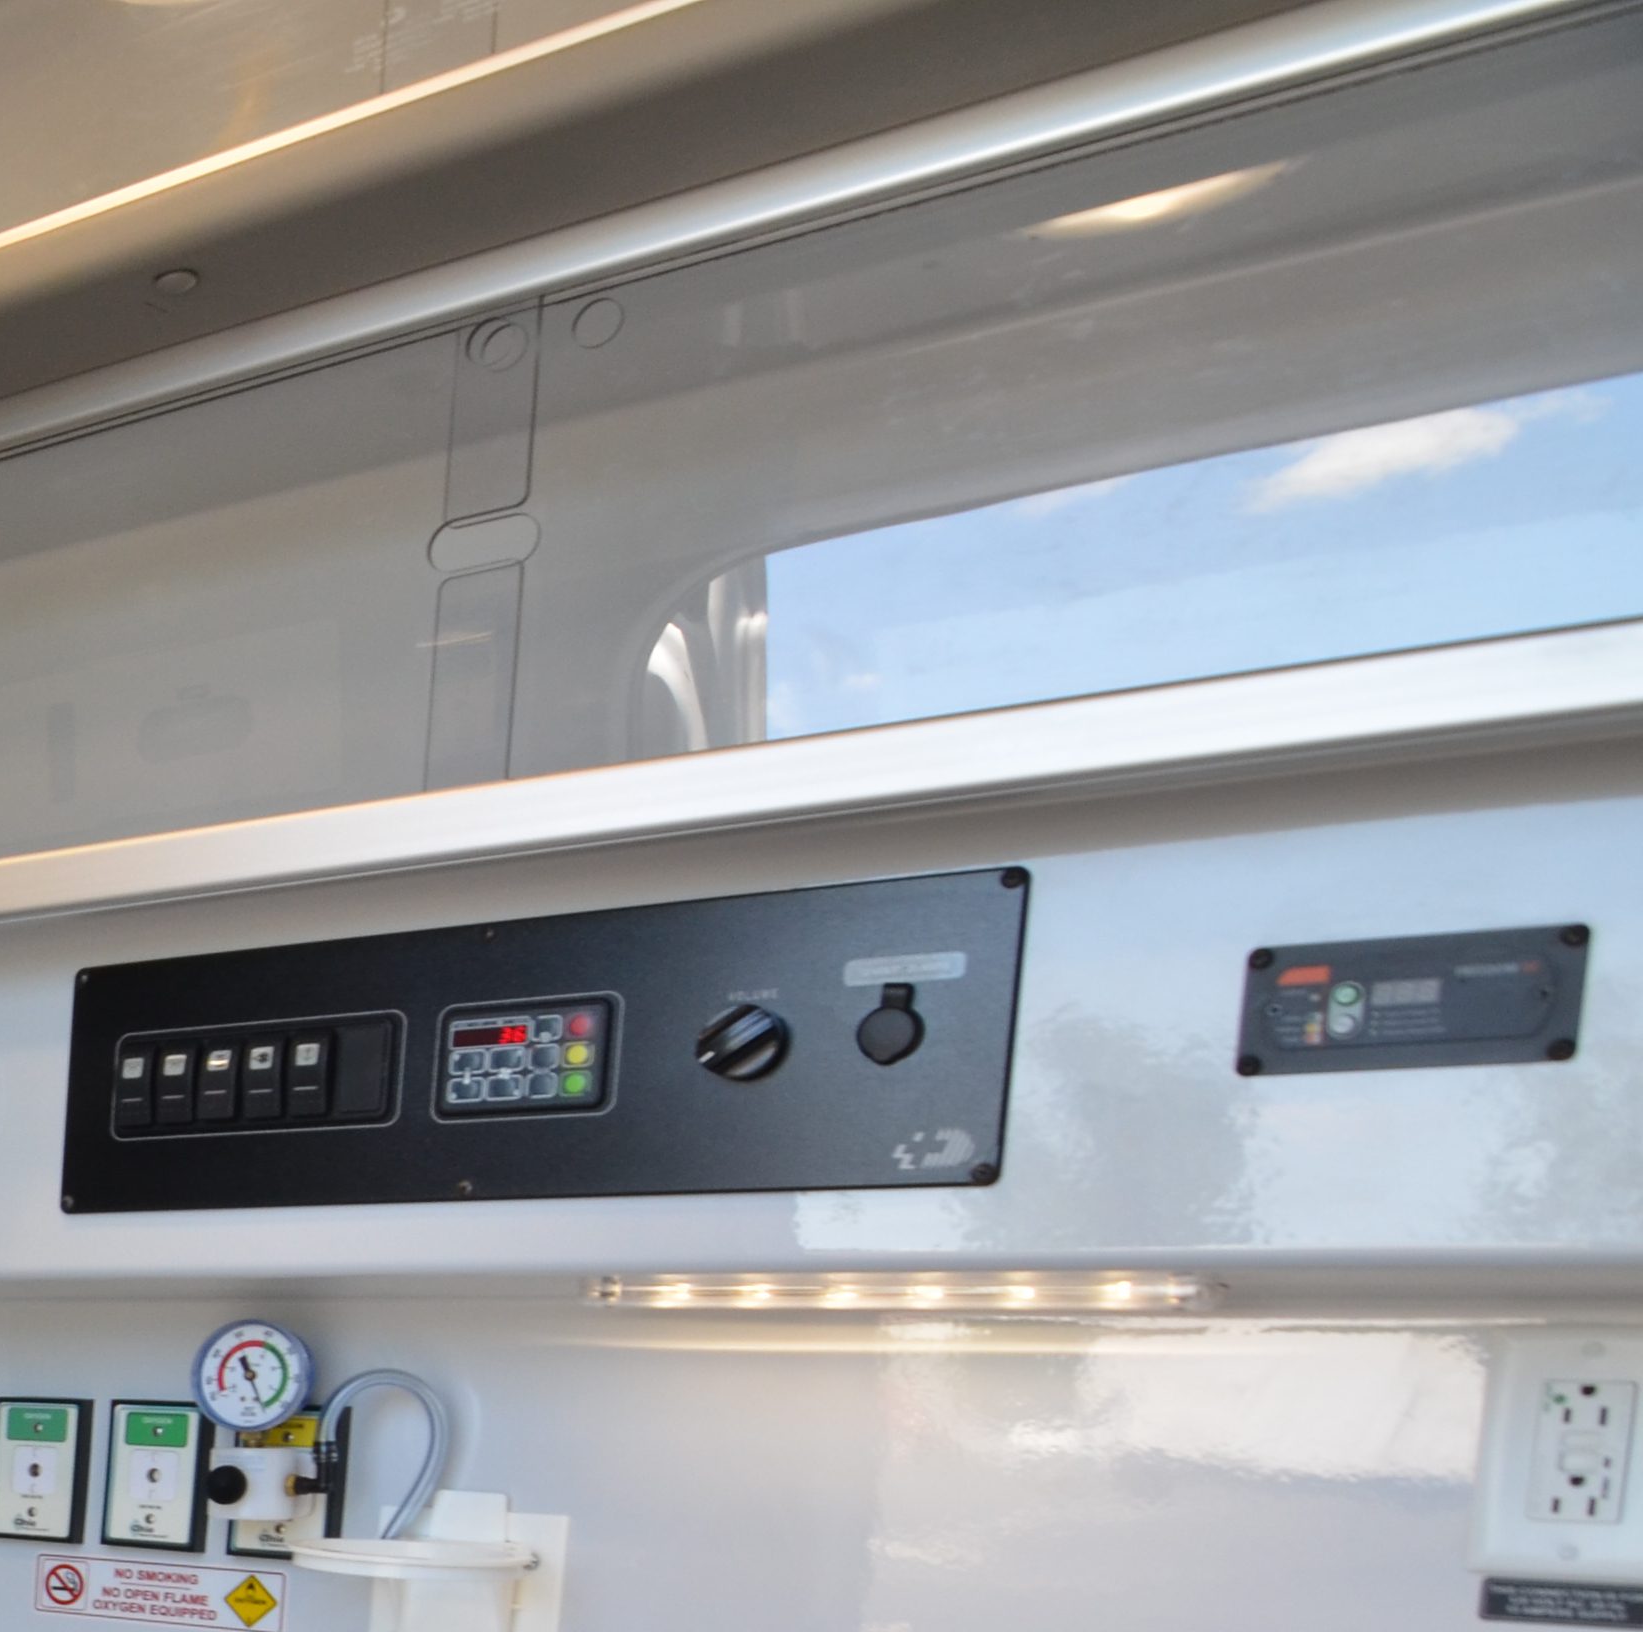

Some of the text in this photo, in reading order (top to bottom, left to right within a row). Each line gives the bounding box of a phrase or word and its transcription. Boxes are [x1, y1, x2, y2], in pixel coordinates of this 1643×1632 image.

[115, 1568, 199, 1585] NO SMOKING
[102, 1587, 209, 1606] NO OPEN FLAME
[93, 1599, 218, 1621] OXYGEN EQUIPPED
